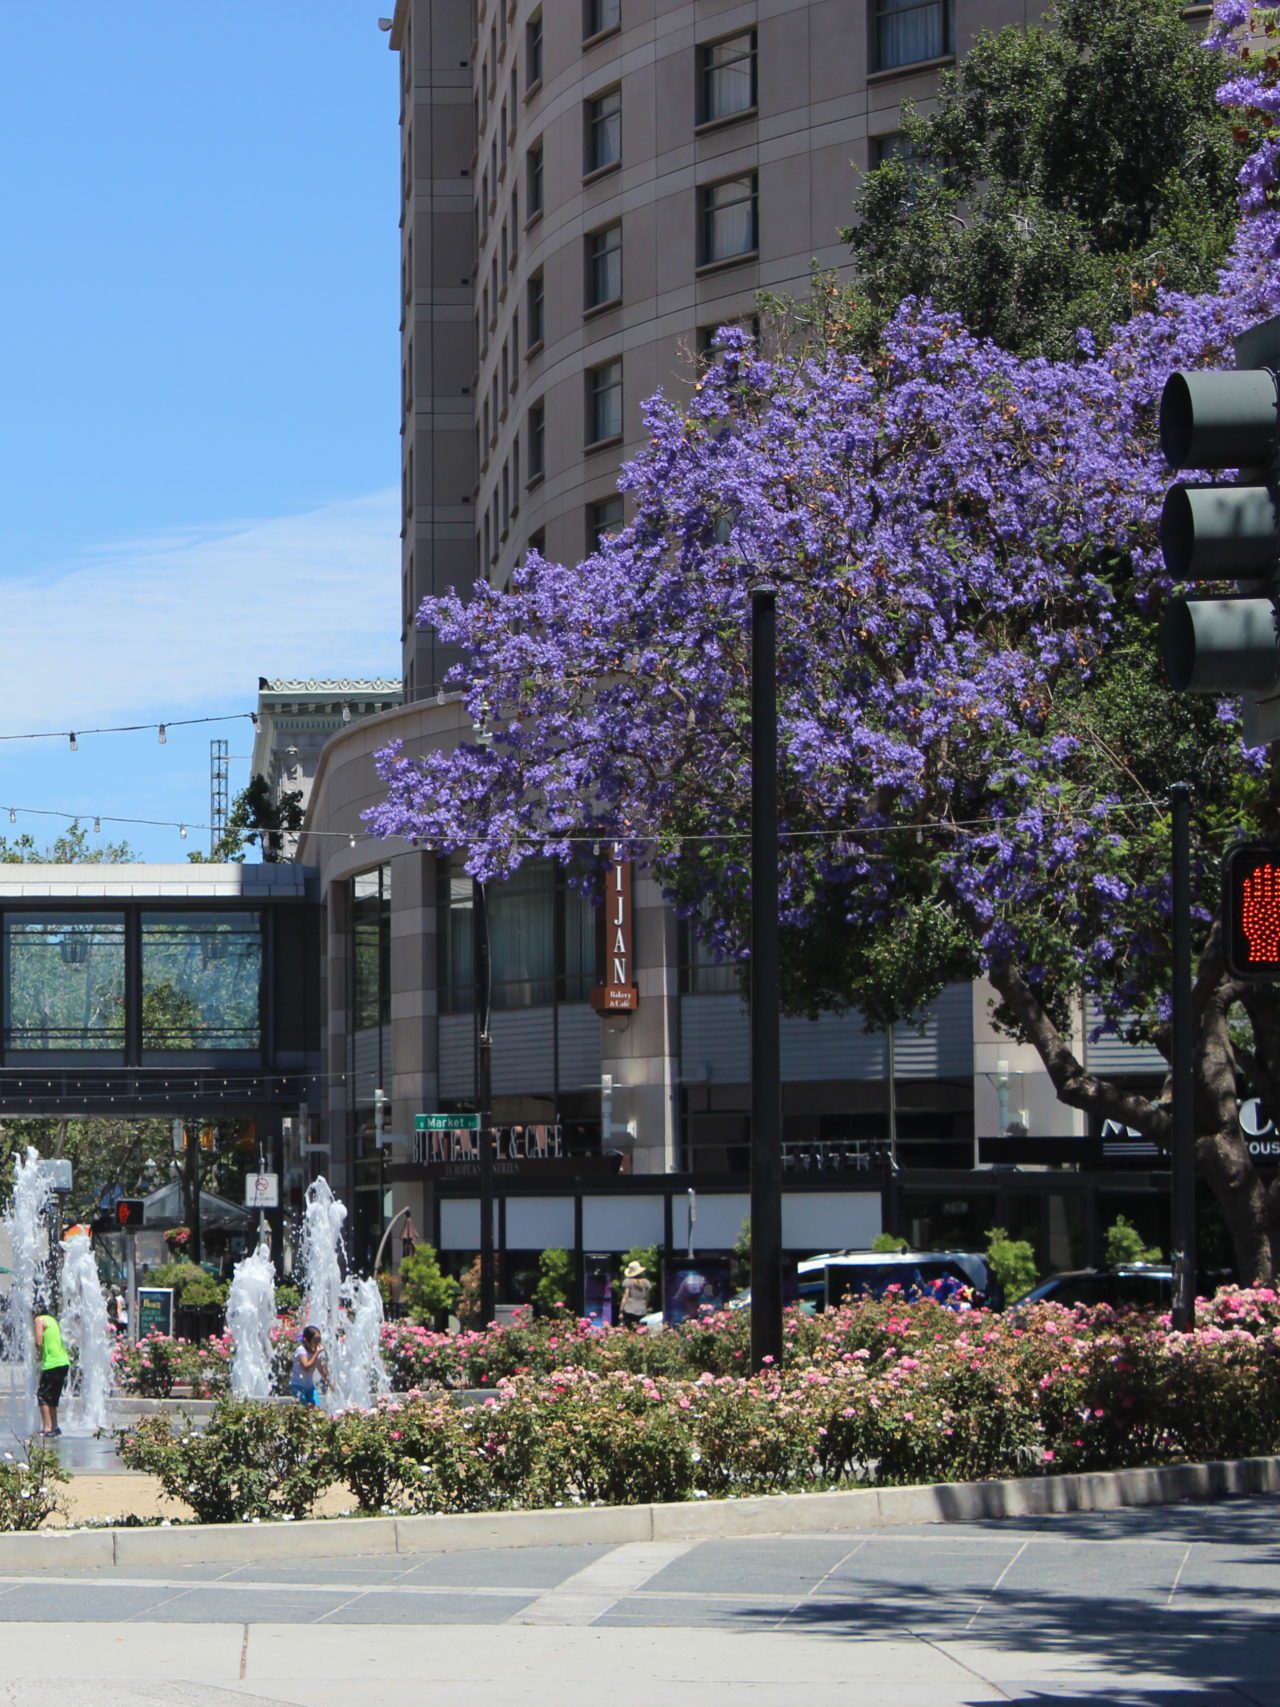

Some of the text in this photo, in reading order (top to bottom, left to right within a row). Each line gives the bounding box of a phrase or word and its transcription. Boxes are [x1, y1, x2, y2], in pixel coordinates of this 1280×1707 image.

[610, 990, 631, 1001] Bakery
[427, 1117, 464, 1129] Market
[412, 1130, 448, 1166] BIJAN
[450, 1126, 510, 1161] BAKY
[525, 1113, 564, 1159] CAFÉ
[1248, 1141, 1280, 1155] OUS
